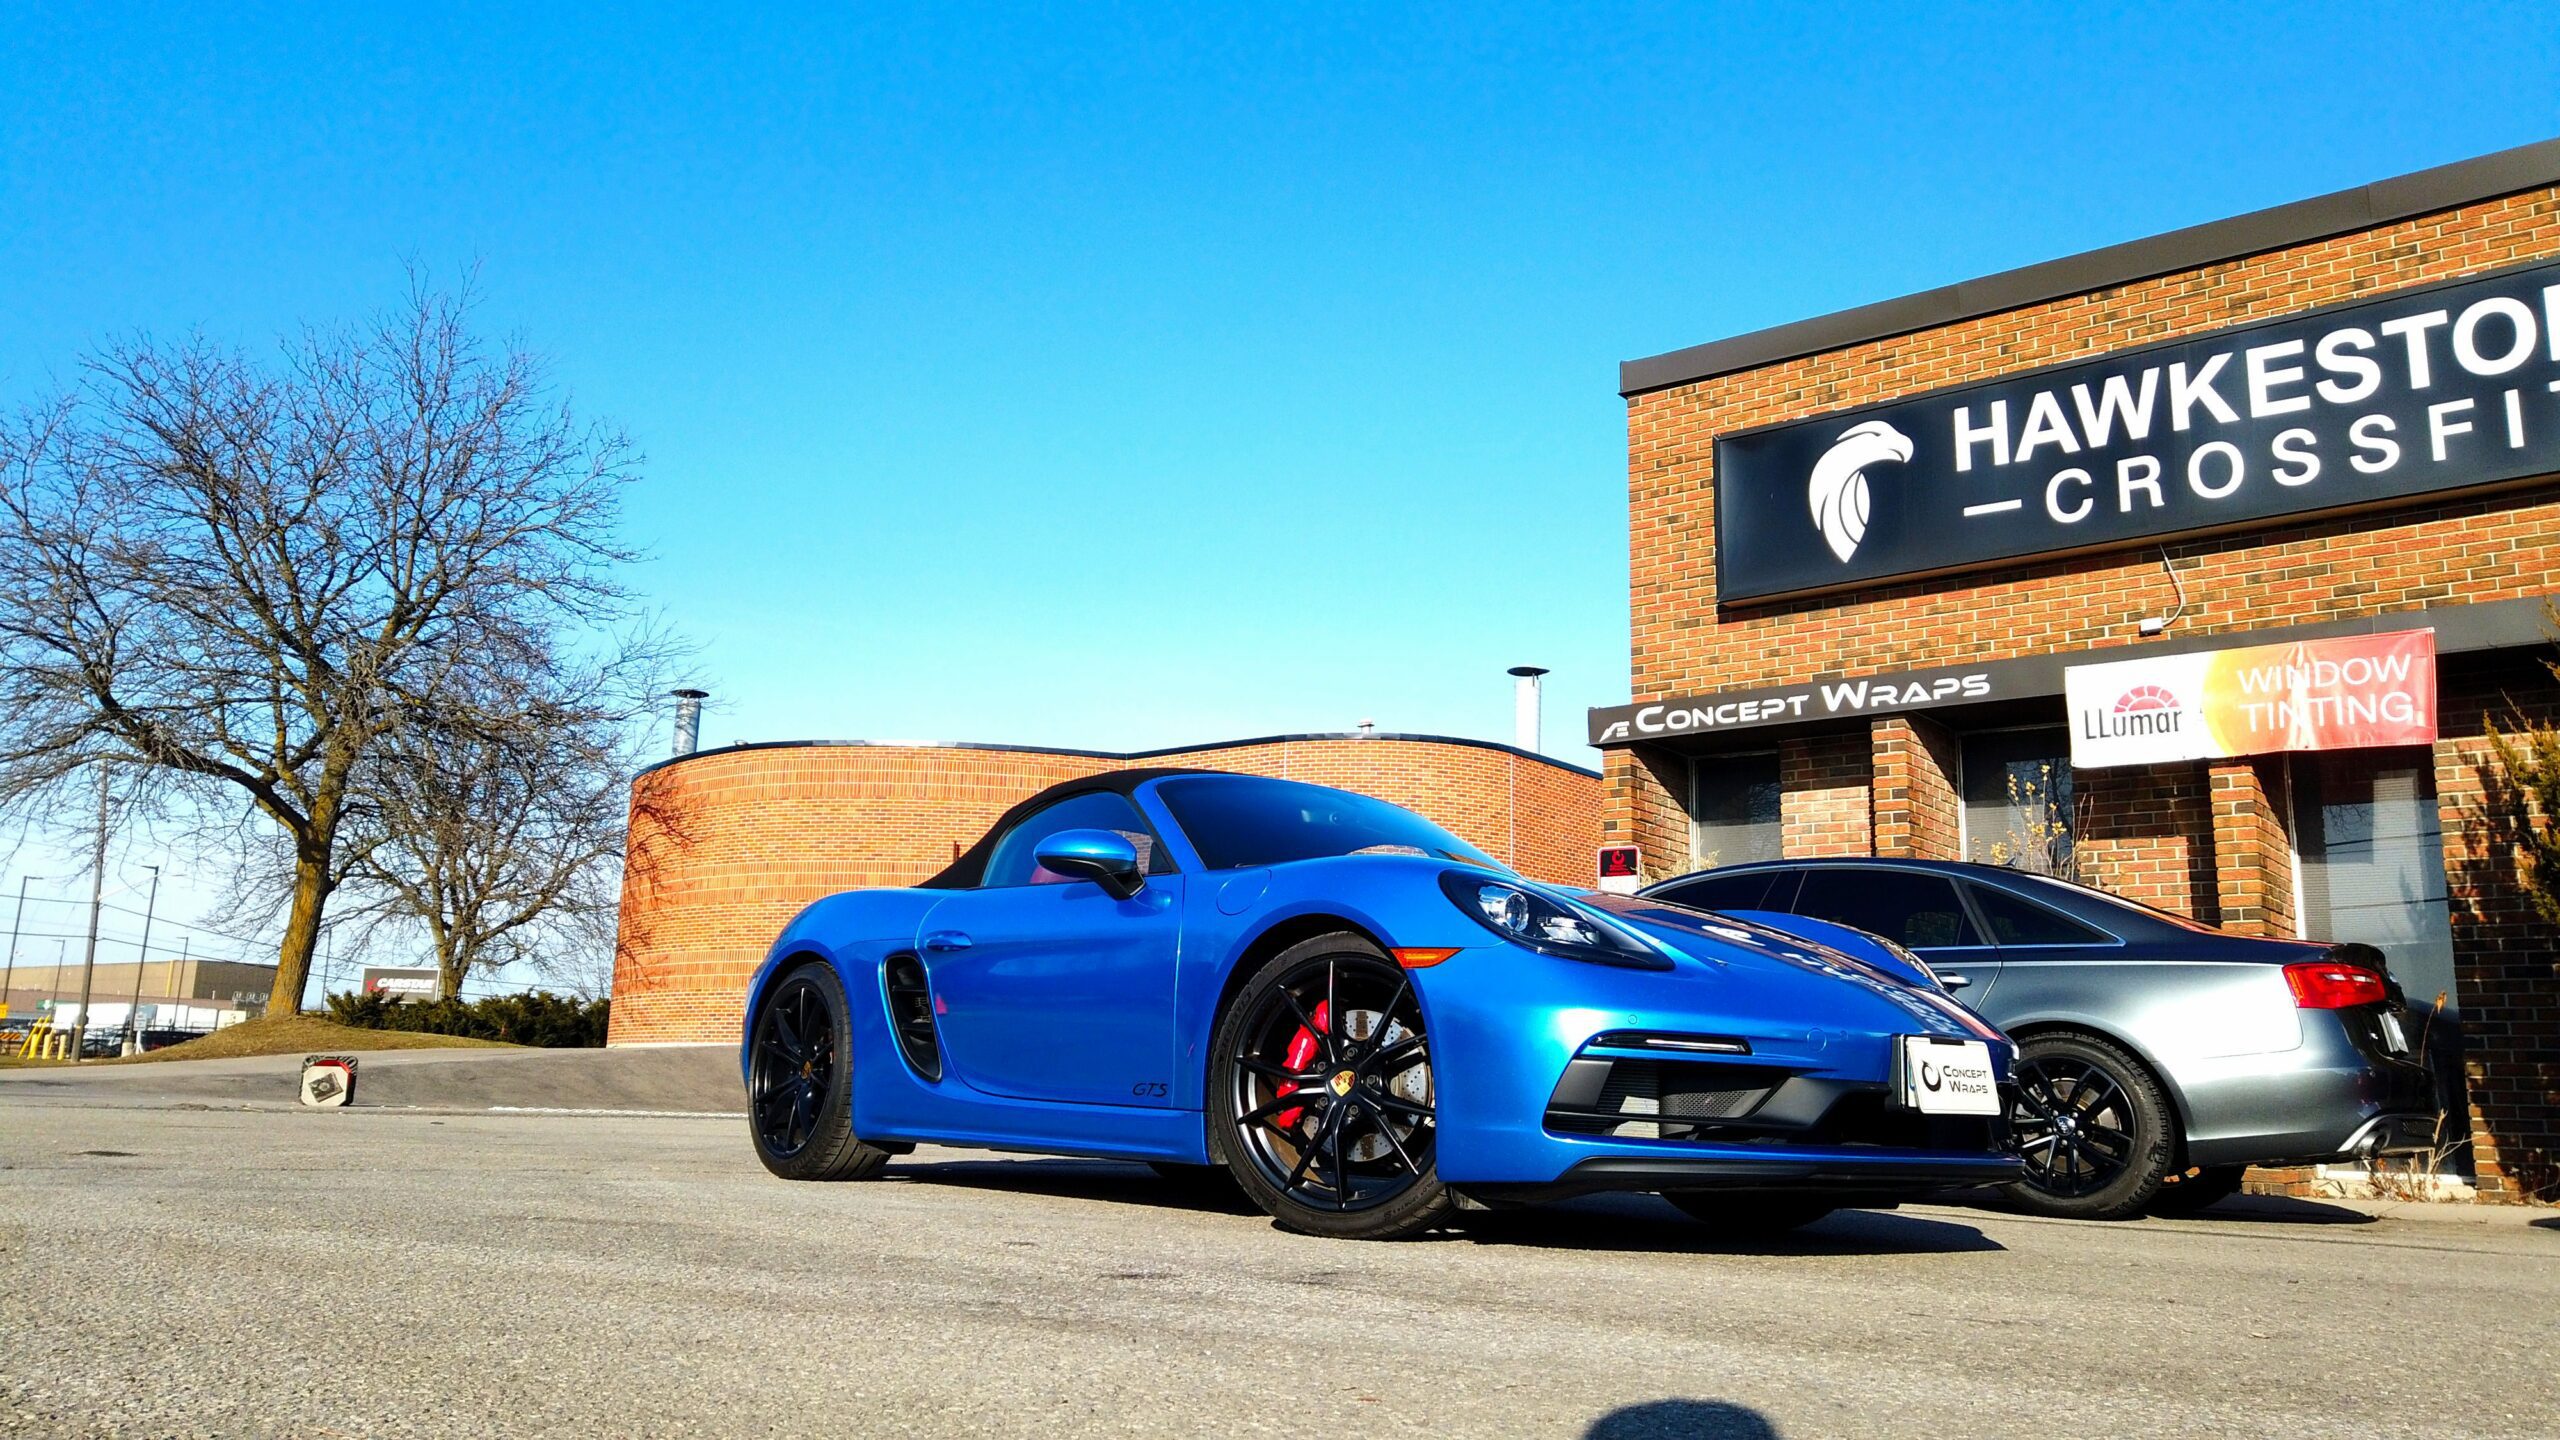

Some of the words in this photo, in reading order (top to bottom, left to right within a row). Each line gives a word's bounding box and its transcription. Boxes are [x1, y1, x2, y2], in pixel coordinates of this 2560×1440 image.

[1953, 284, 2560, 473] HAWKESTO
[2045, 380, 2560, 525] CROSSFI
[2237, 653, 2412, 695] WINDOW
[1635, 694, 1810, 733] CONCEPT
[1820, 673, 1991, 712] WRAPS
[2084, 707, 2183, 740] LLumar
[2238, 690, 2414, 733] TINTING
[1132, 1082, 1168, 1098] GTS
[1943, 1065, 1987, 1079] CONCEPT
[1948, 1080, 1989, 1094] WRAPS
